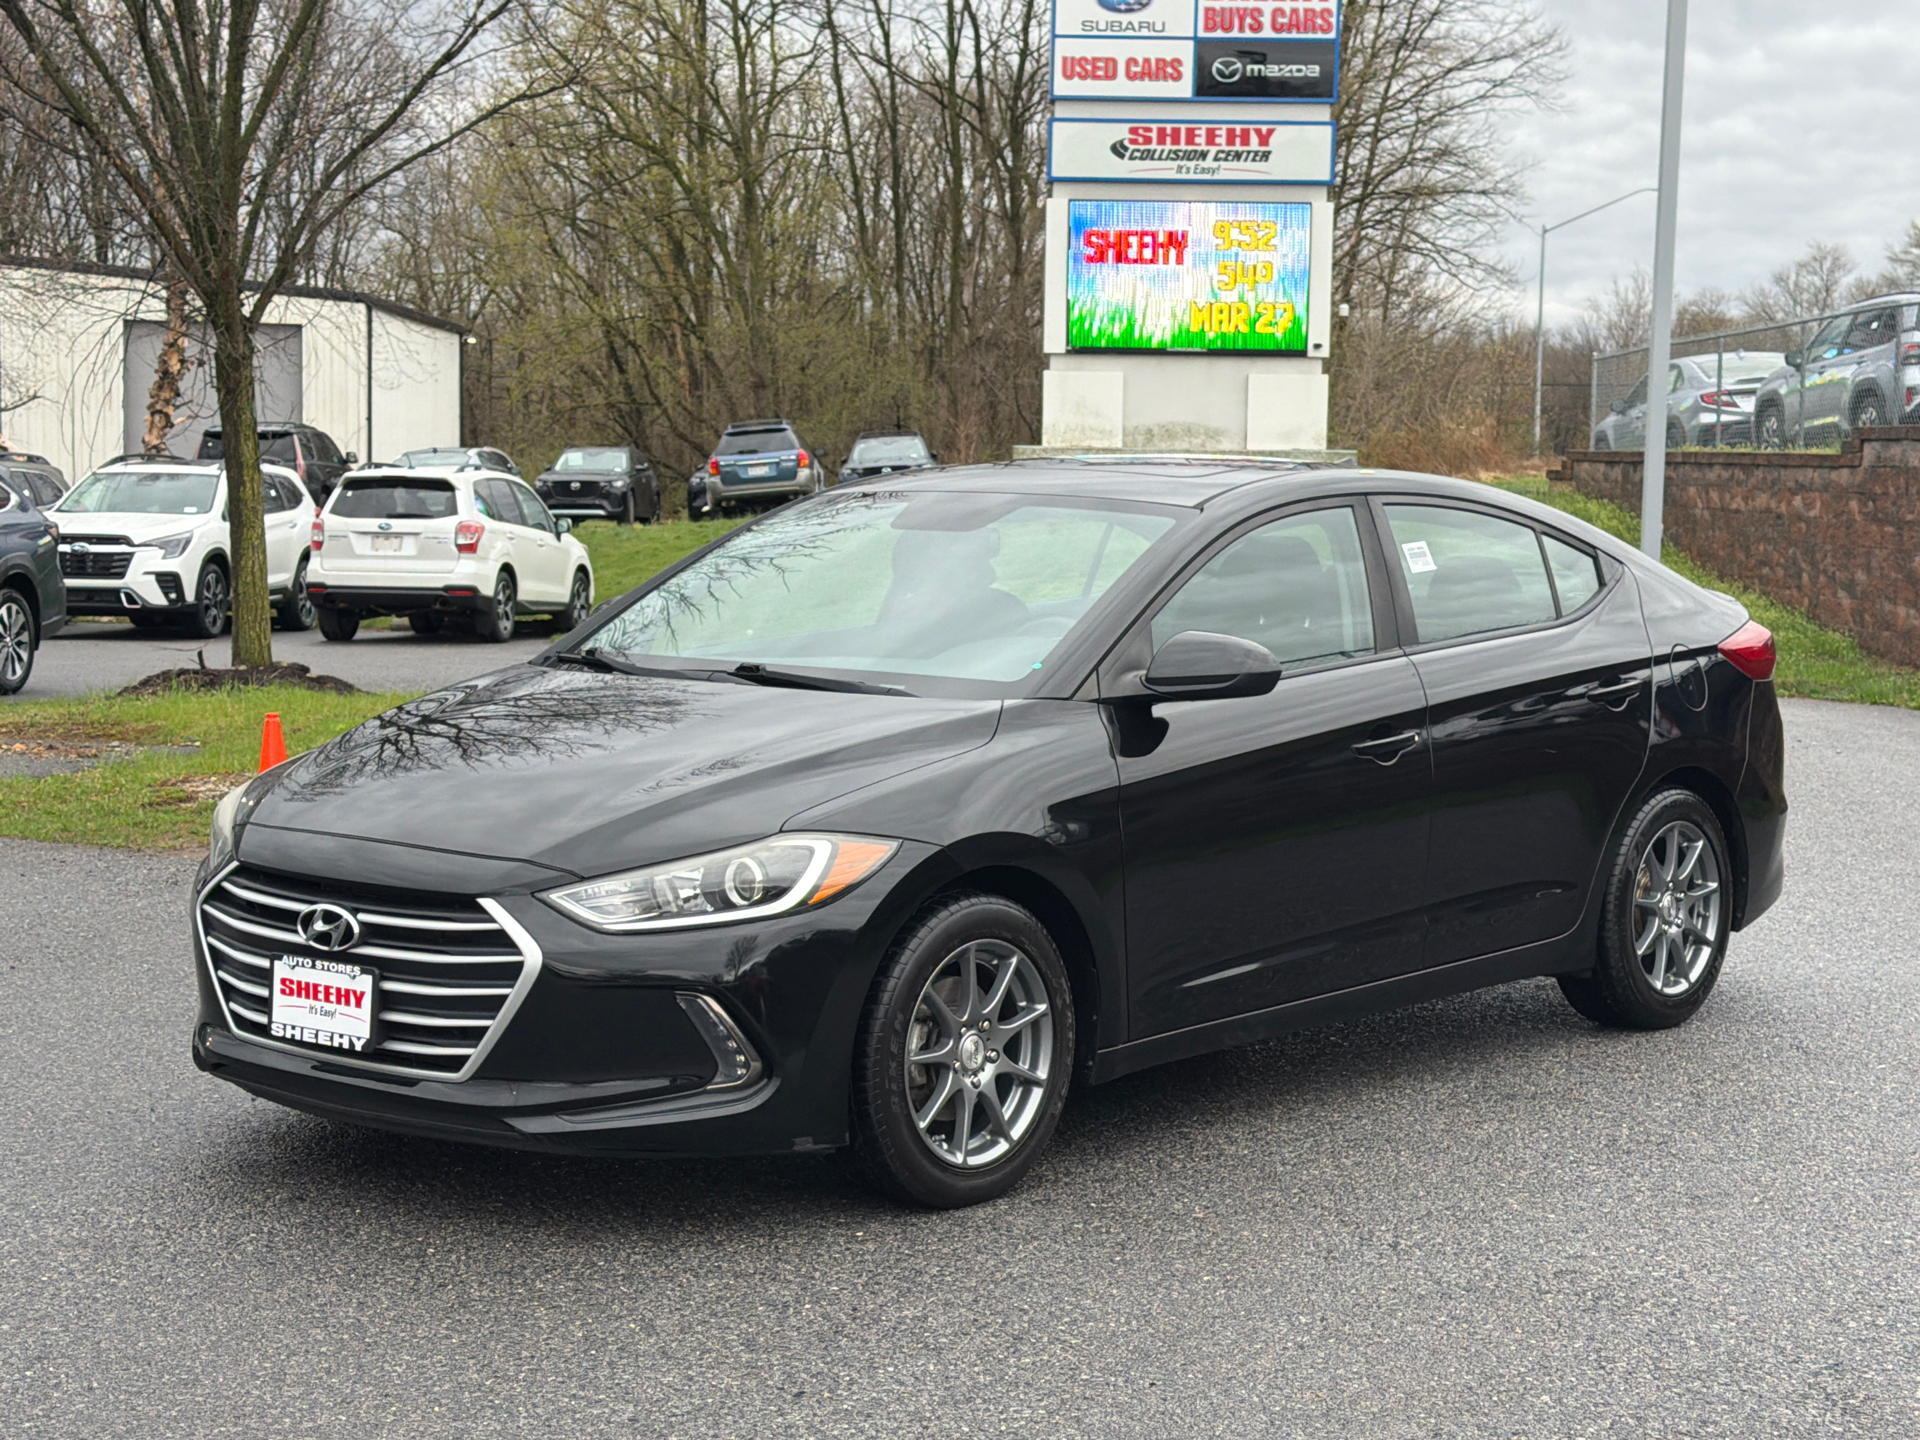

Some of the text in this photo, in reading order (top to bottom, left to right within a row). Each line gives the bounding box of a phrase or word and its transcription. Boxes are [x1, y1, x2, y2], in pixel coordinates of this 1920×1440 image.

[1081, 20, 1166, 33] SUBARU
[1204, 7, 1334, 33] BUYS CARS
[1061, 56, 1184, 82] USED CARS
[1246, 62, 1321, 78] mazda
[1128, 126, 1276, 147] SHEEHY
[1127, 148, 1272, 163] COLLISION CENTER
[1175, 164, 1222, 177] It's Easy!
[1213, 220, 1277, 251] 9:52
[1083, 229, 1189, 266] SHEEHY
[1190, 301, 1294, 334] MAR 27
[281, 955, 362, 976] AUTO STORES
[280, 977, 367, 1009] SHEEHY
[308, 1003, 337, 1020] It's Easy!
[270, 1022, 368, 1052] SHEEHY
